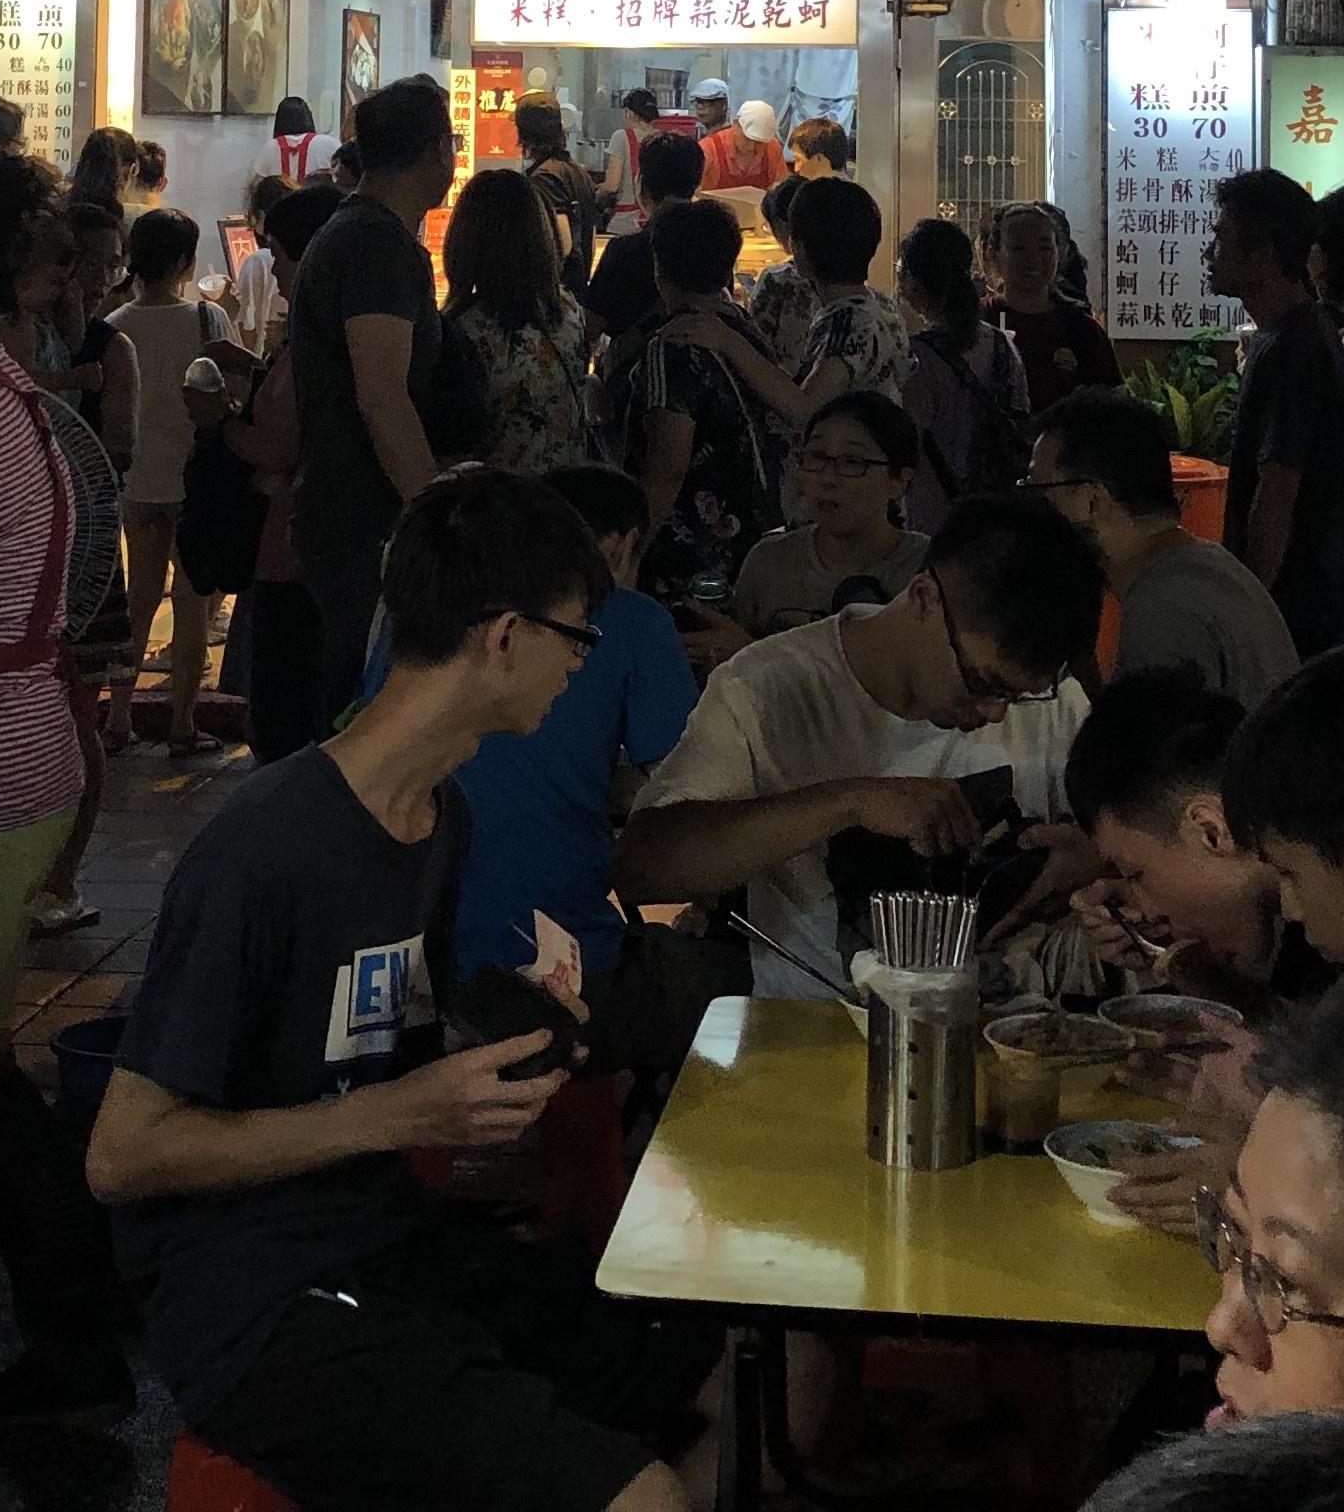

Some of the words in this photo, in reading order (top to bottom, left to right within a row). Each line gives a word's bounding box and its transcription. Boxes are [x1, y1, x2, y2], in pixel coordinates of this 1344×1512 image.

[38, 32, 63, 51] 70
[56, 57, 72, 72] 40
[55, 80, 71, 95] 60
[55, 103, 71, 118] 60
[55, 126, 70, 140] 70
[1133, 117, 1168, 138] 30
[1192, 117, 1227, 139] 70
[54, 148, 70, 162] 70
[1116, 146, 1179, 172] 米糕
[1226, 148, 1244, 174] 40
